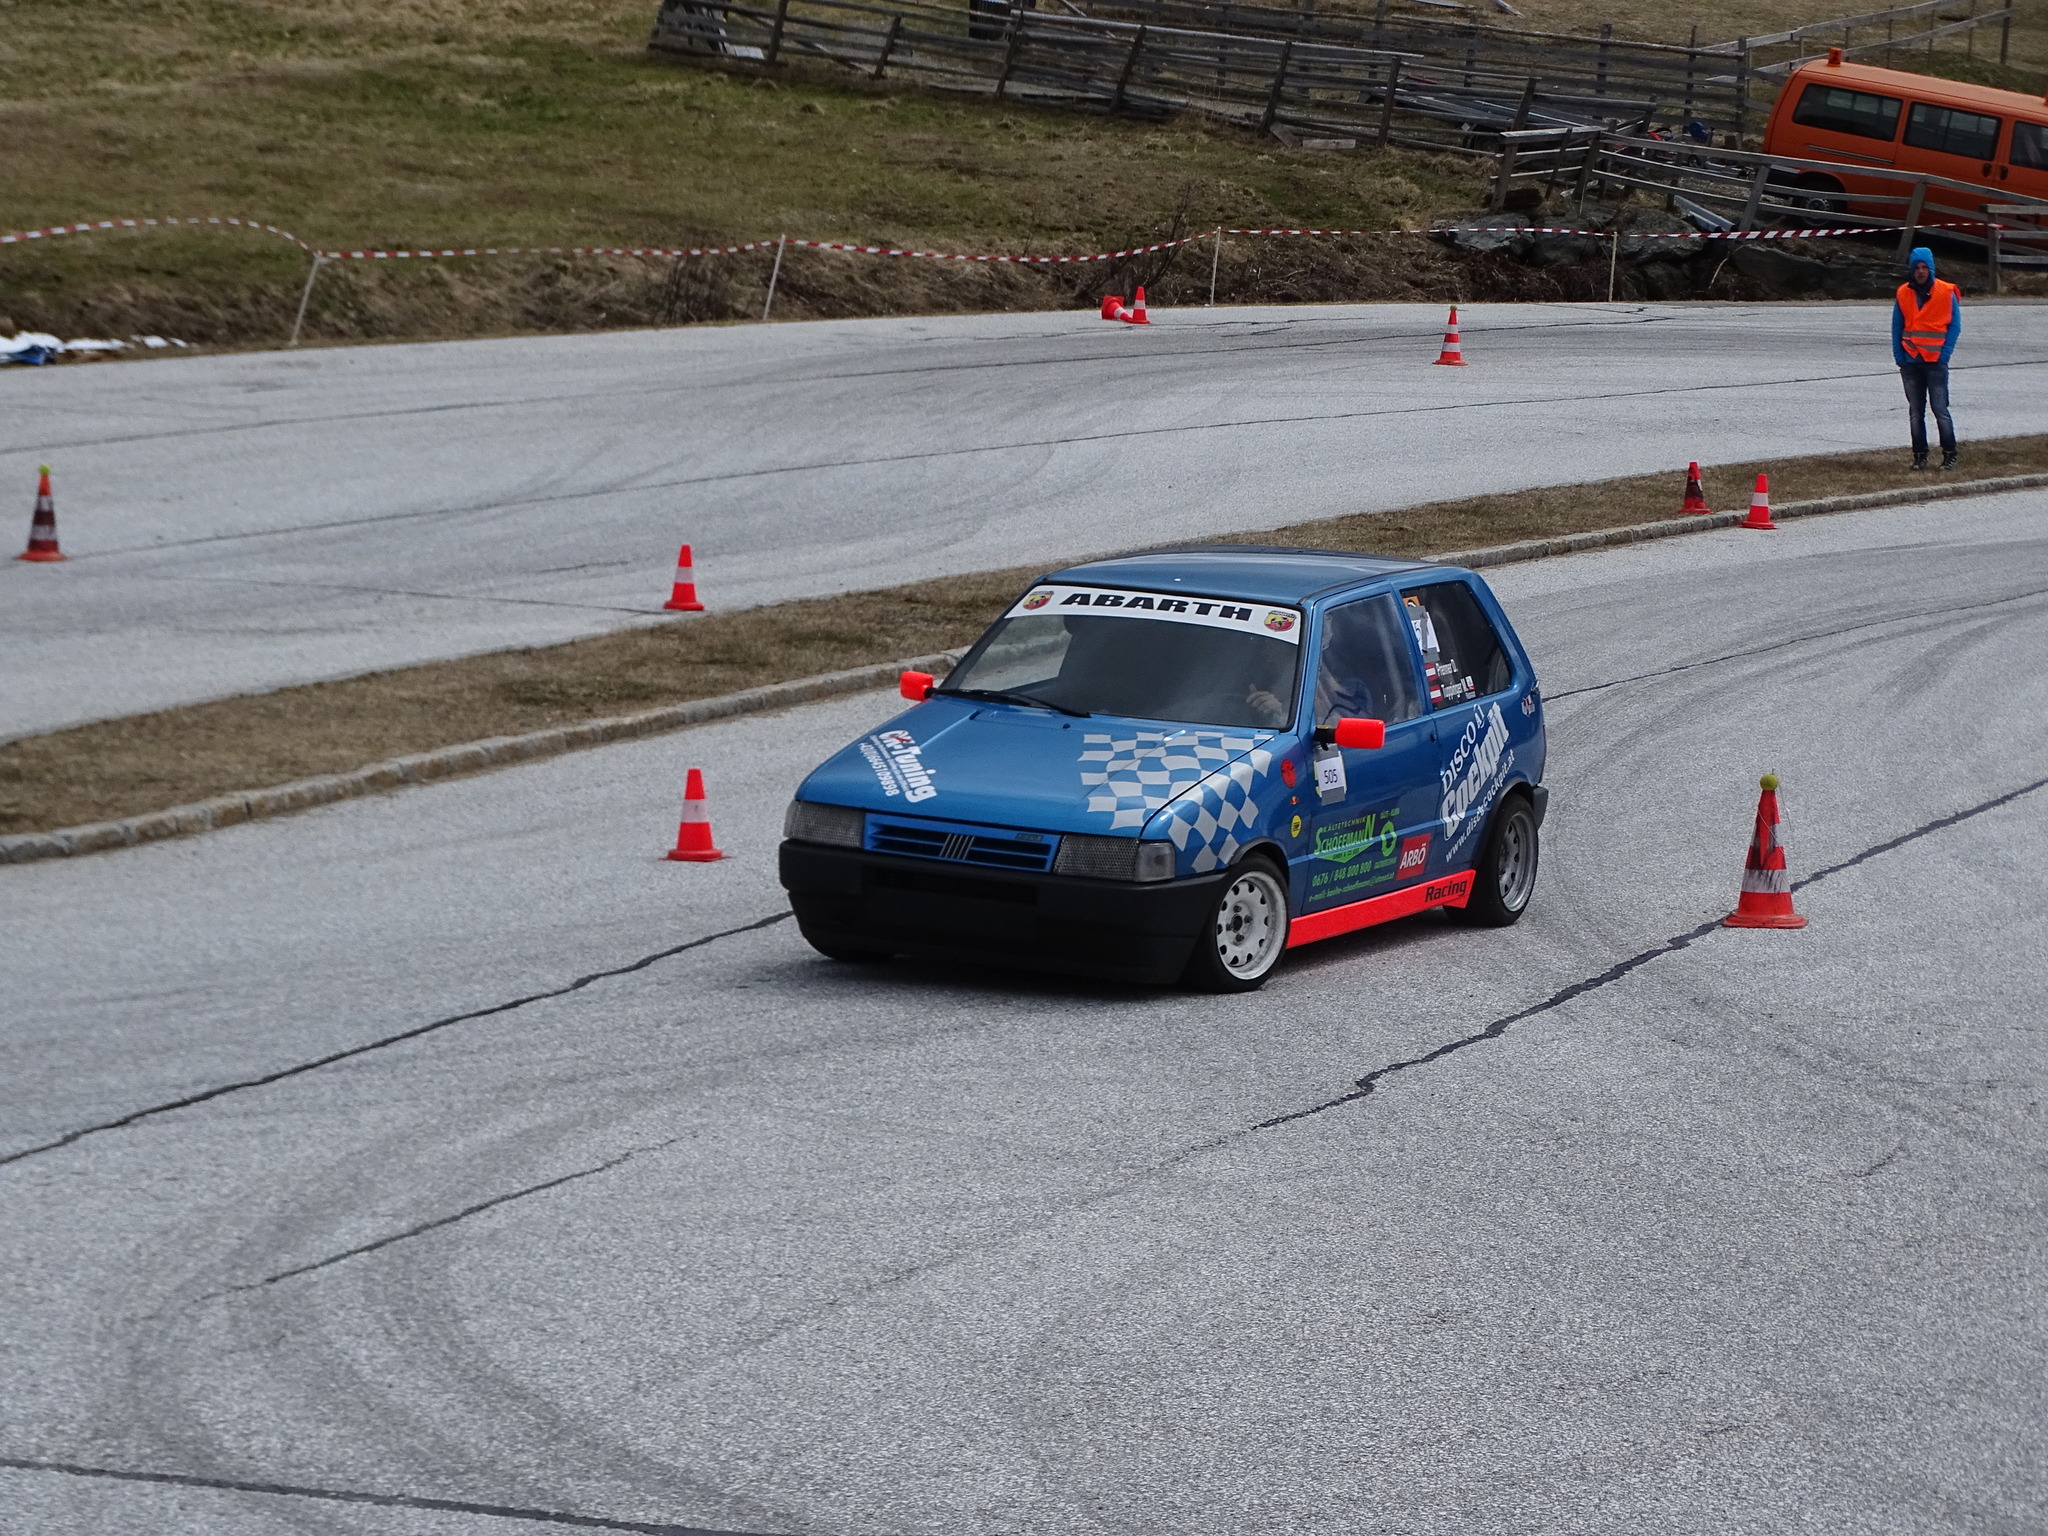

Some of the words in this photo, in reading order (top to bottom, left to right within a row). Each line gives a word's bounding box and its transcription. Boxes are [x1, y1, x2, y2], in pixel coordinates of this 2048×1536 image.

[1059, 593, 1253, 622] ABARTH
[1441, 721, 1477, 796] DISCO
[1323, 769, 1339, 785] 505
[1400, 843, 1427, 870] ARBÖ
[1425, 880, 1468, 902] Racing
